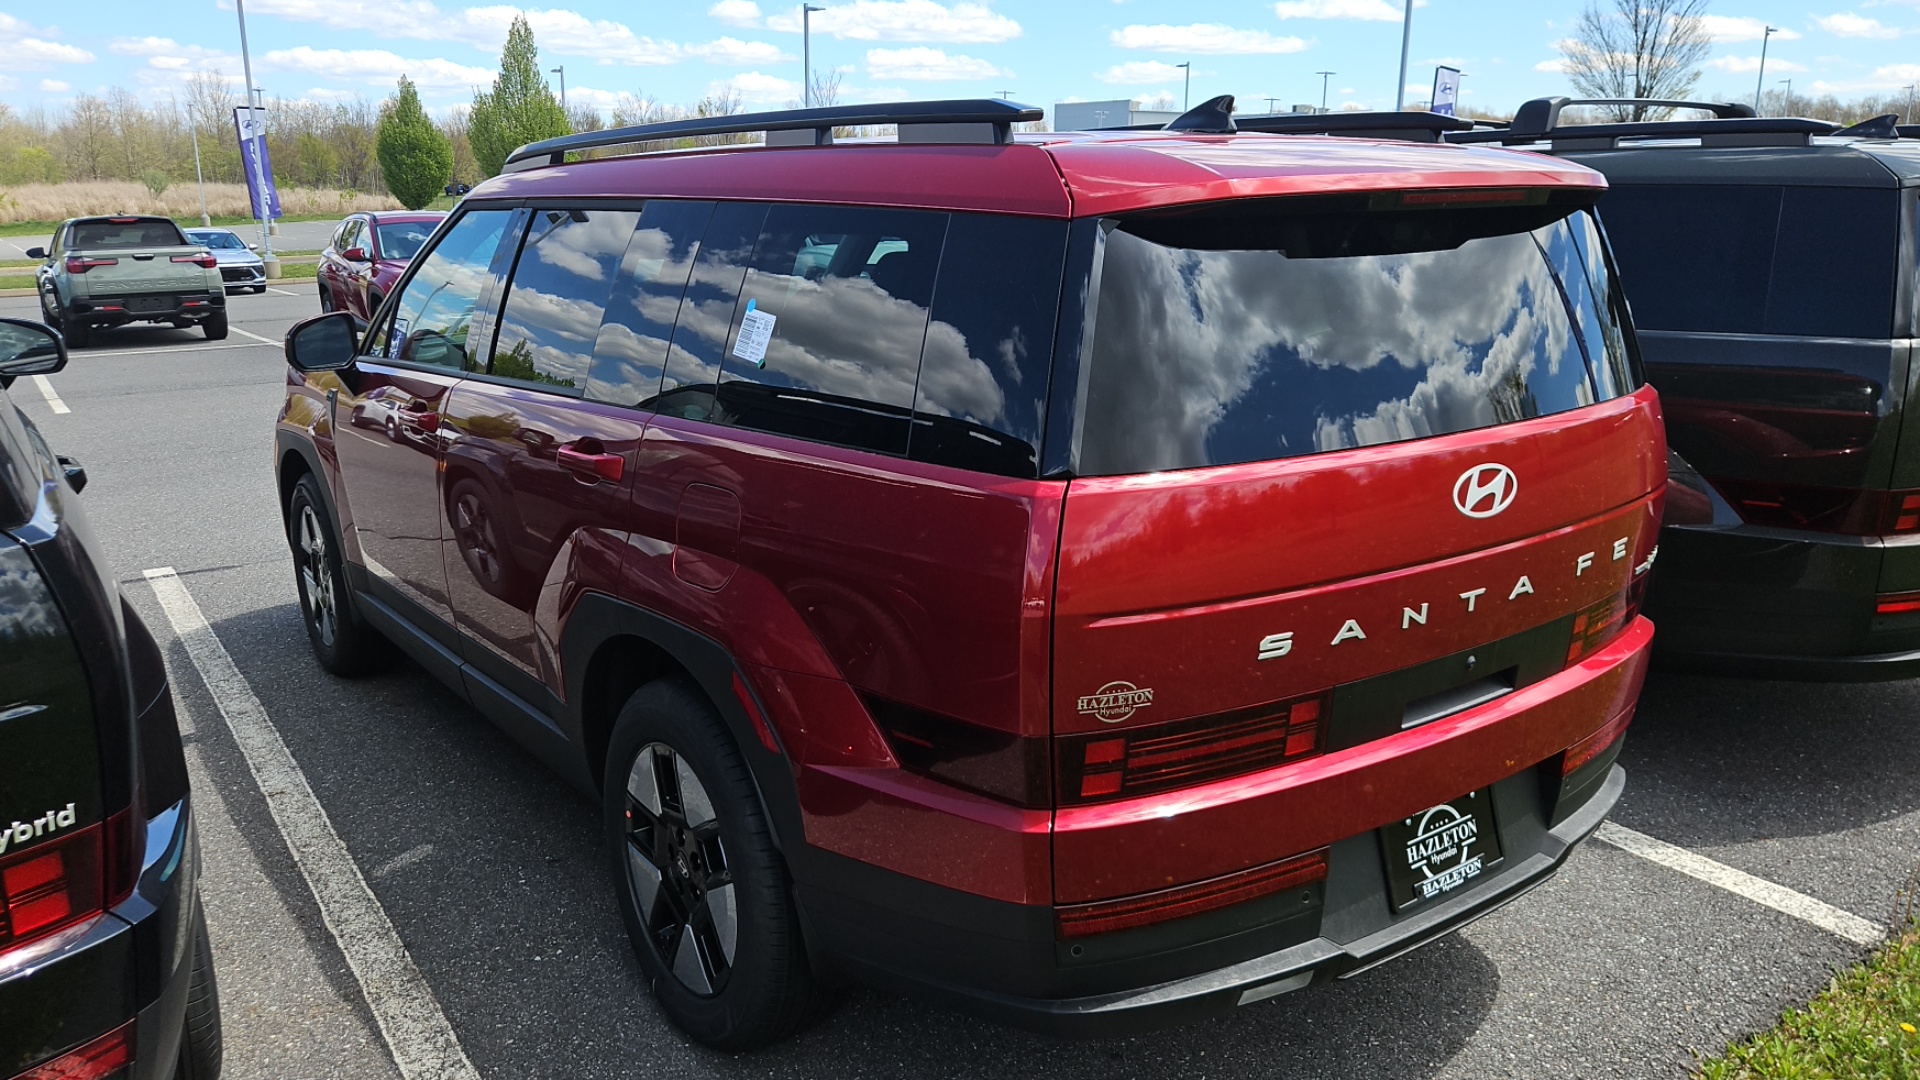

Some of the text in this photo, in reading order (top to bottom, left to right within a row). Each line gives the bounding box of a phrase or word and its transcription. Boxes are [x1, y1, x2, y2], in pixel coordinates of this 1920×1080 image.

[93, 277, 201, 289] SANTA CRUZ
[1257, 575, 1535, 660] SANTA
[1576, 536, 1629, 576] FE
[1077, 690, 1154, 710] HAZLETON
[1100, 705, 1132, 717] Hyundai
[1406, 818, 1478, 864] HAZLETON
[1430, 845, 1458, 865] Hyundai
[1422, 859, 1483, 896] HAZLETON
[1442, 879, 1464, 893] Hyundai
